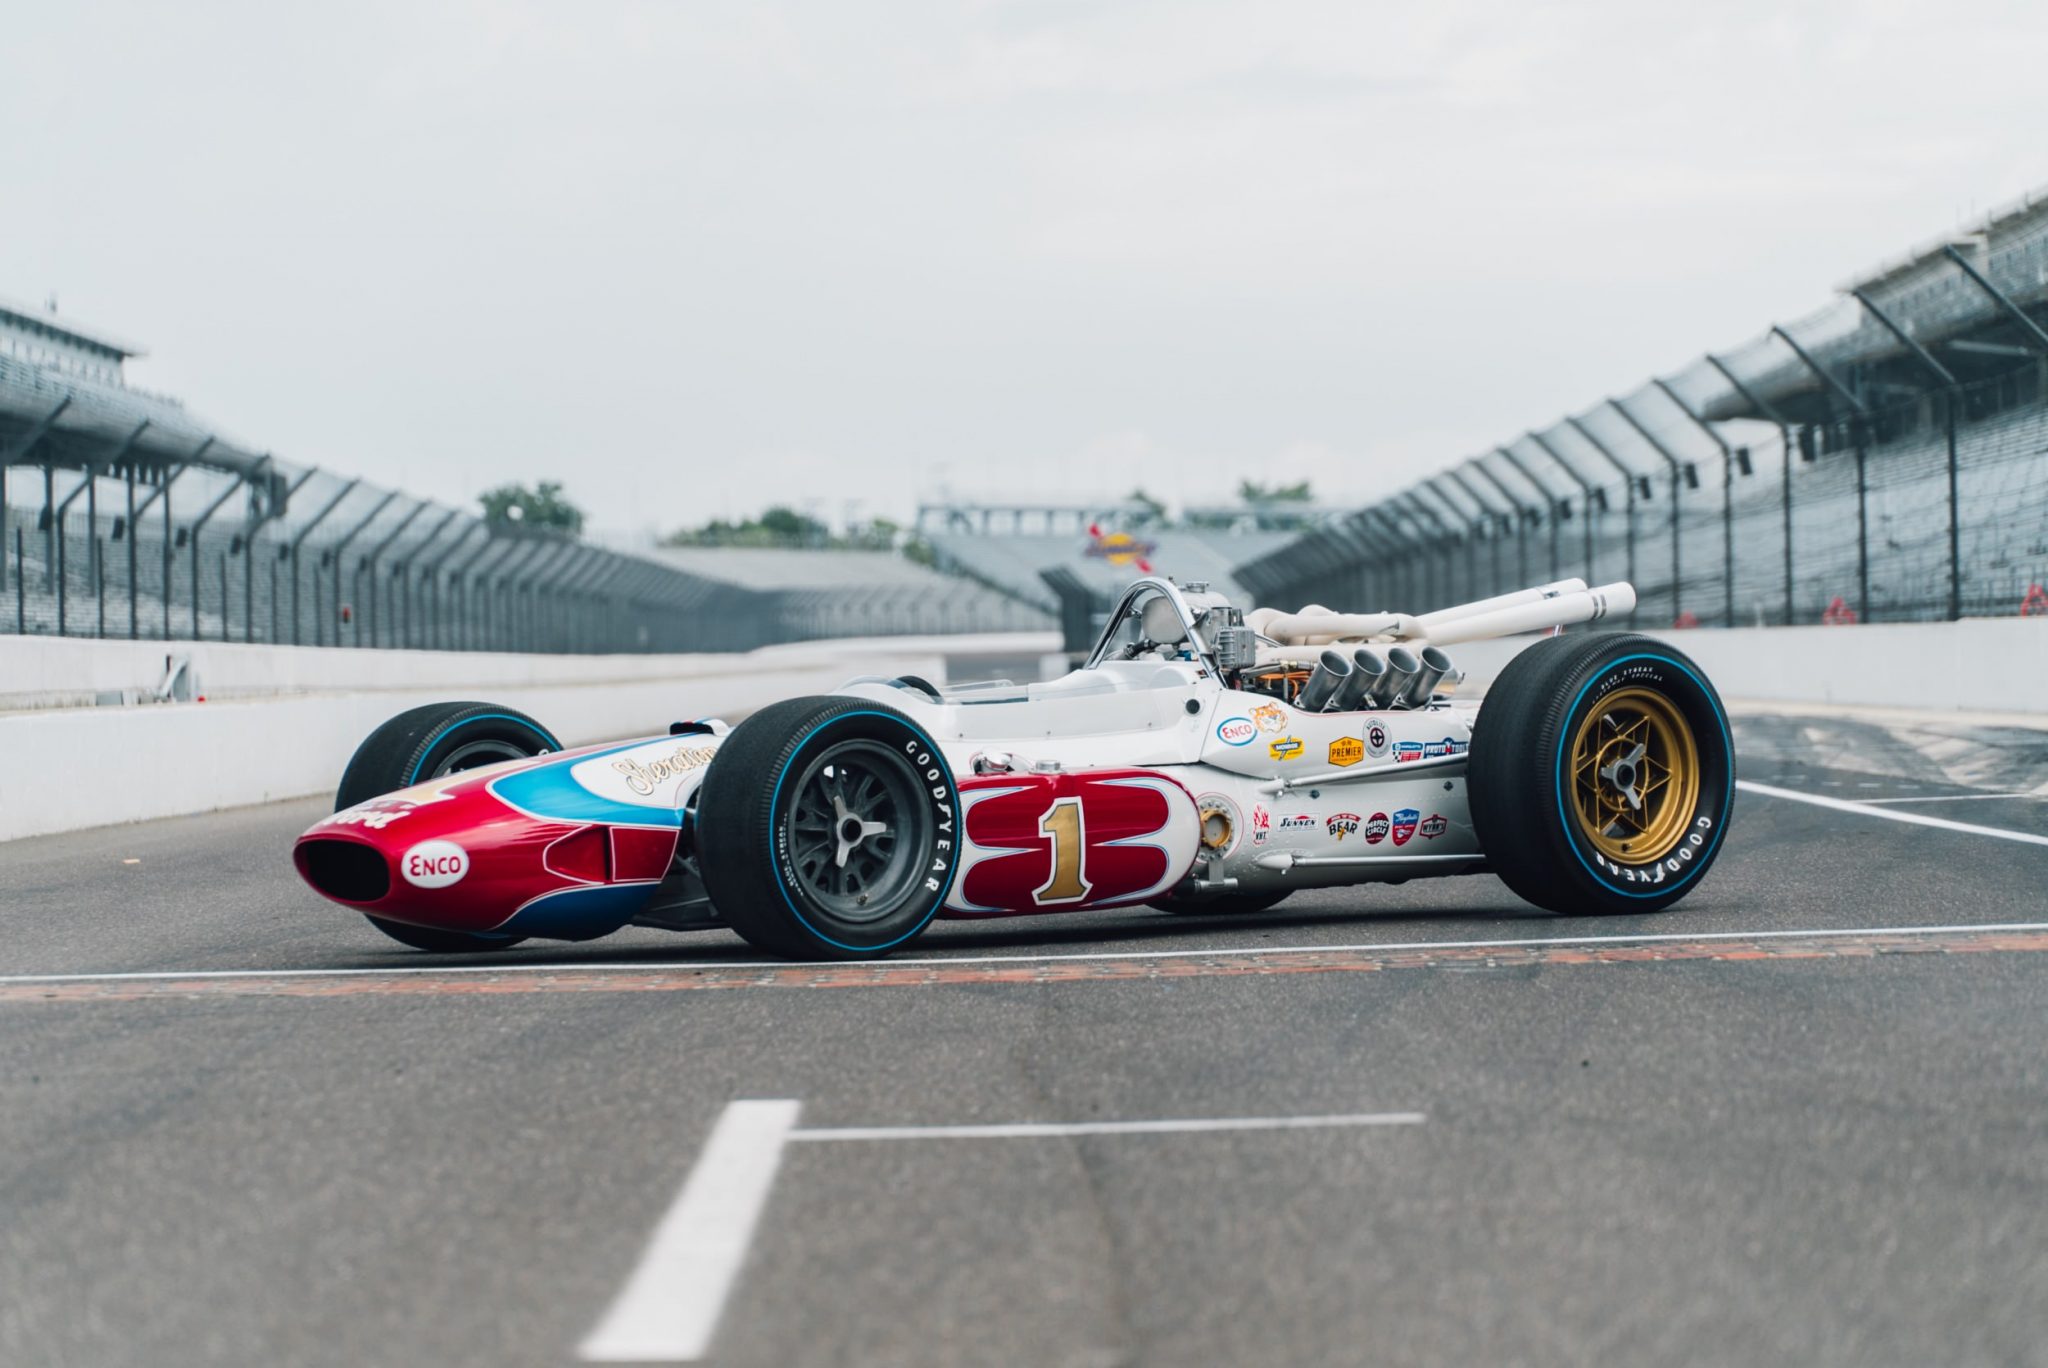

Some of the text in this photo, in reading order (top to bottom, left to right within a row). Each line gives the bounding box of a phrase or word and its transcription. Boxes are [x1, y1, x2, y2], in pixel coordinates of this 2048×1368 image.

[1222, 724, 1253, 739] ENCO
[1331, 746, 1362, 758] PREMIER
[1426, 744, 1446, 754] PROTO
[906, 740, 952, 892] GOODYEAR
[1280, 817, 1316, 827] SUNNEN
[1329, 821, 1358, 836] BEAR
[1366, 819, 1389, 829] PERFECT
[1367, 826, 1387, 835] CIRCLE
[1032, 796, 1093, 906] 1
[1596, 816, 1712, 883] GOODYEAR
[410, 855, 461, 877] ENCO
